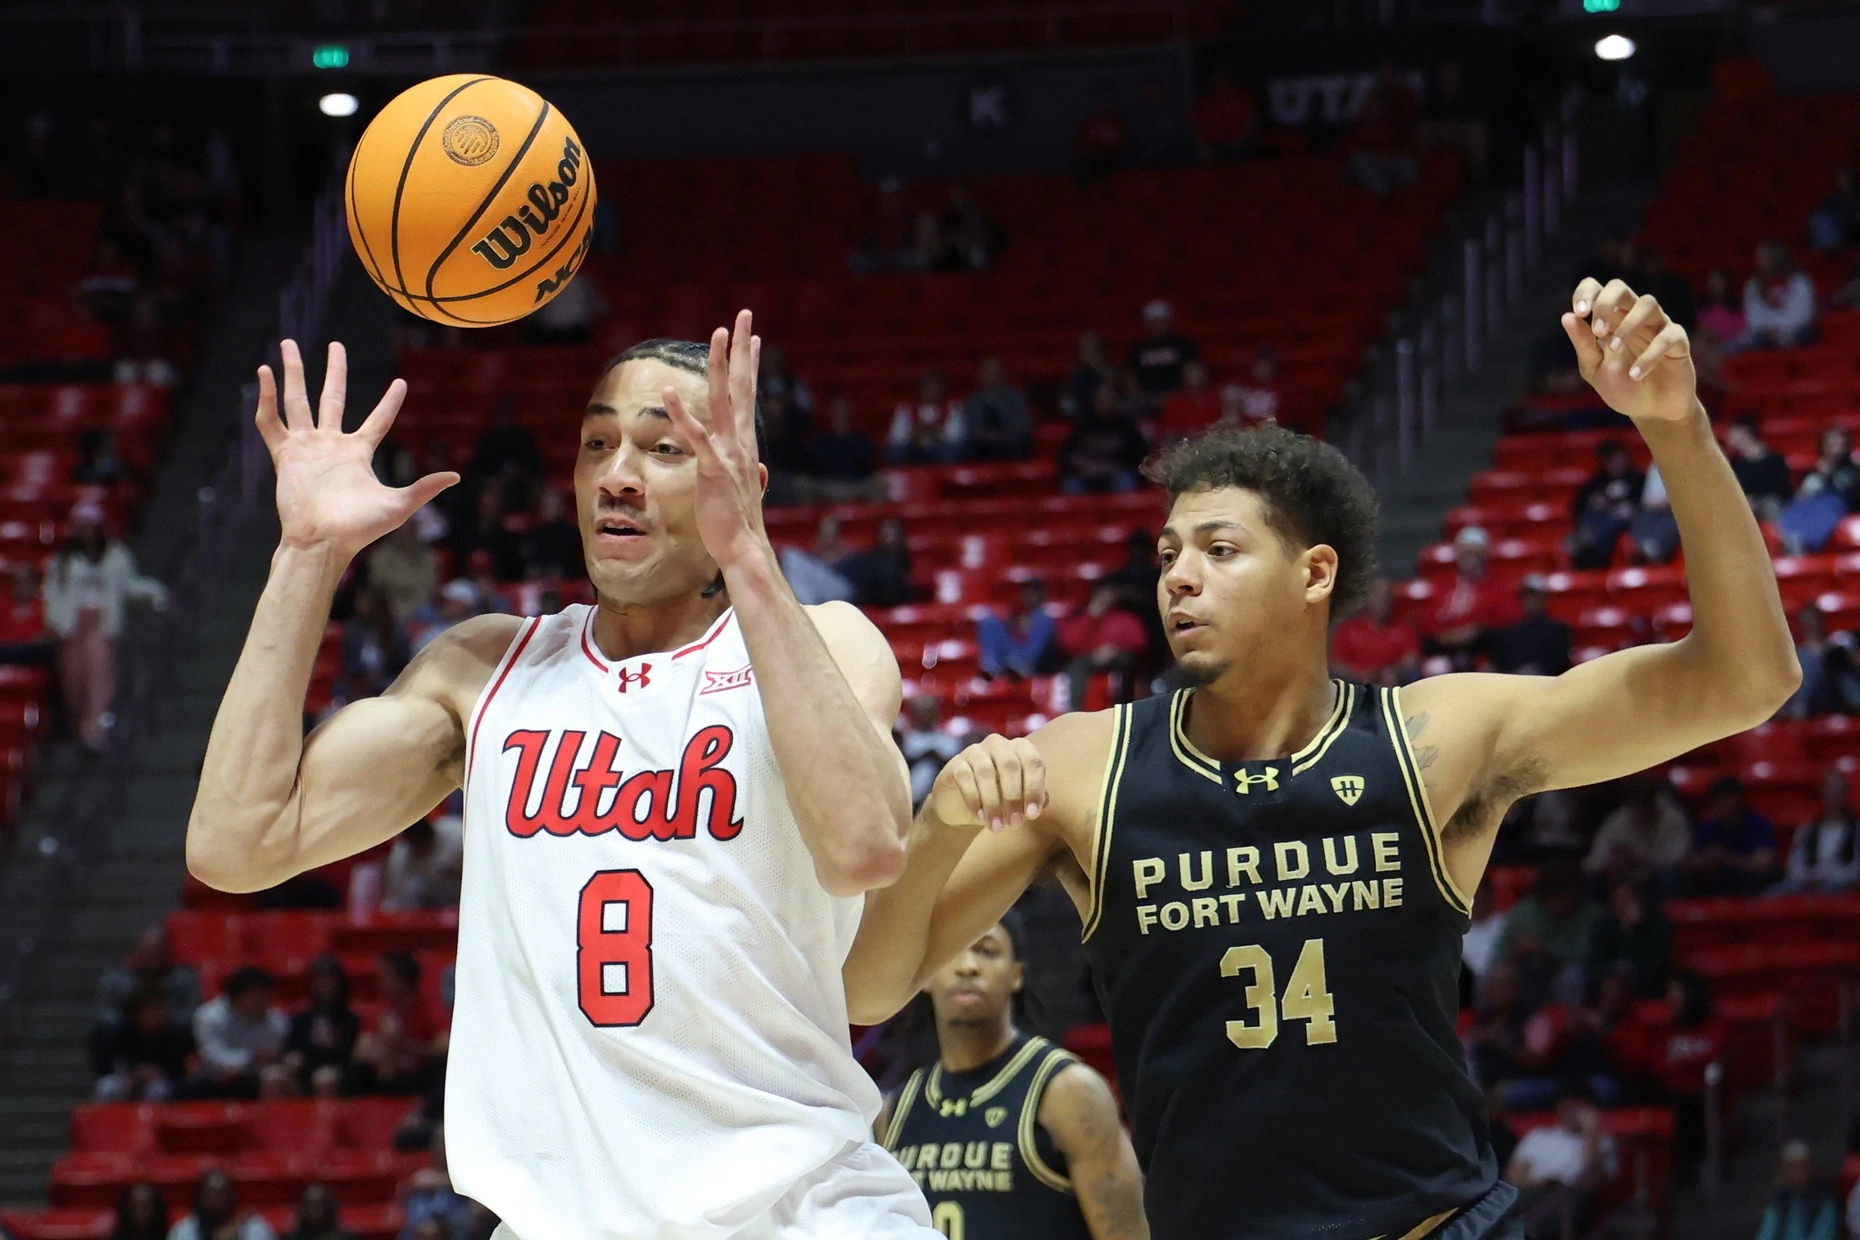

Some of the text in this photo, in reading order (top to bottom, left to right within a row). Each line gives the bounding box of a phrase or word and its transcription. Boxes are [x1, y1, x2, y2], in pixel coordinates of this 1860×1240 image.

[470, 136, 581, 271] Wilson
[502, 724, 744, 842] Utah
[1132, 832, 1401, 899] PURDUE
[1136, 878, 1403, 935] FORT WAYNE
[577, 868, 655, 1028] 8
[1220, 938, 1337, 1049] 34
